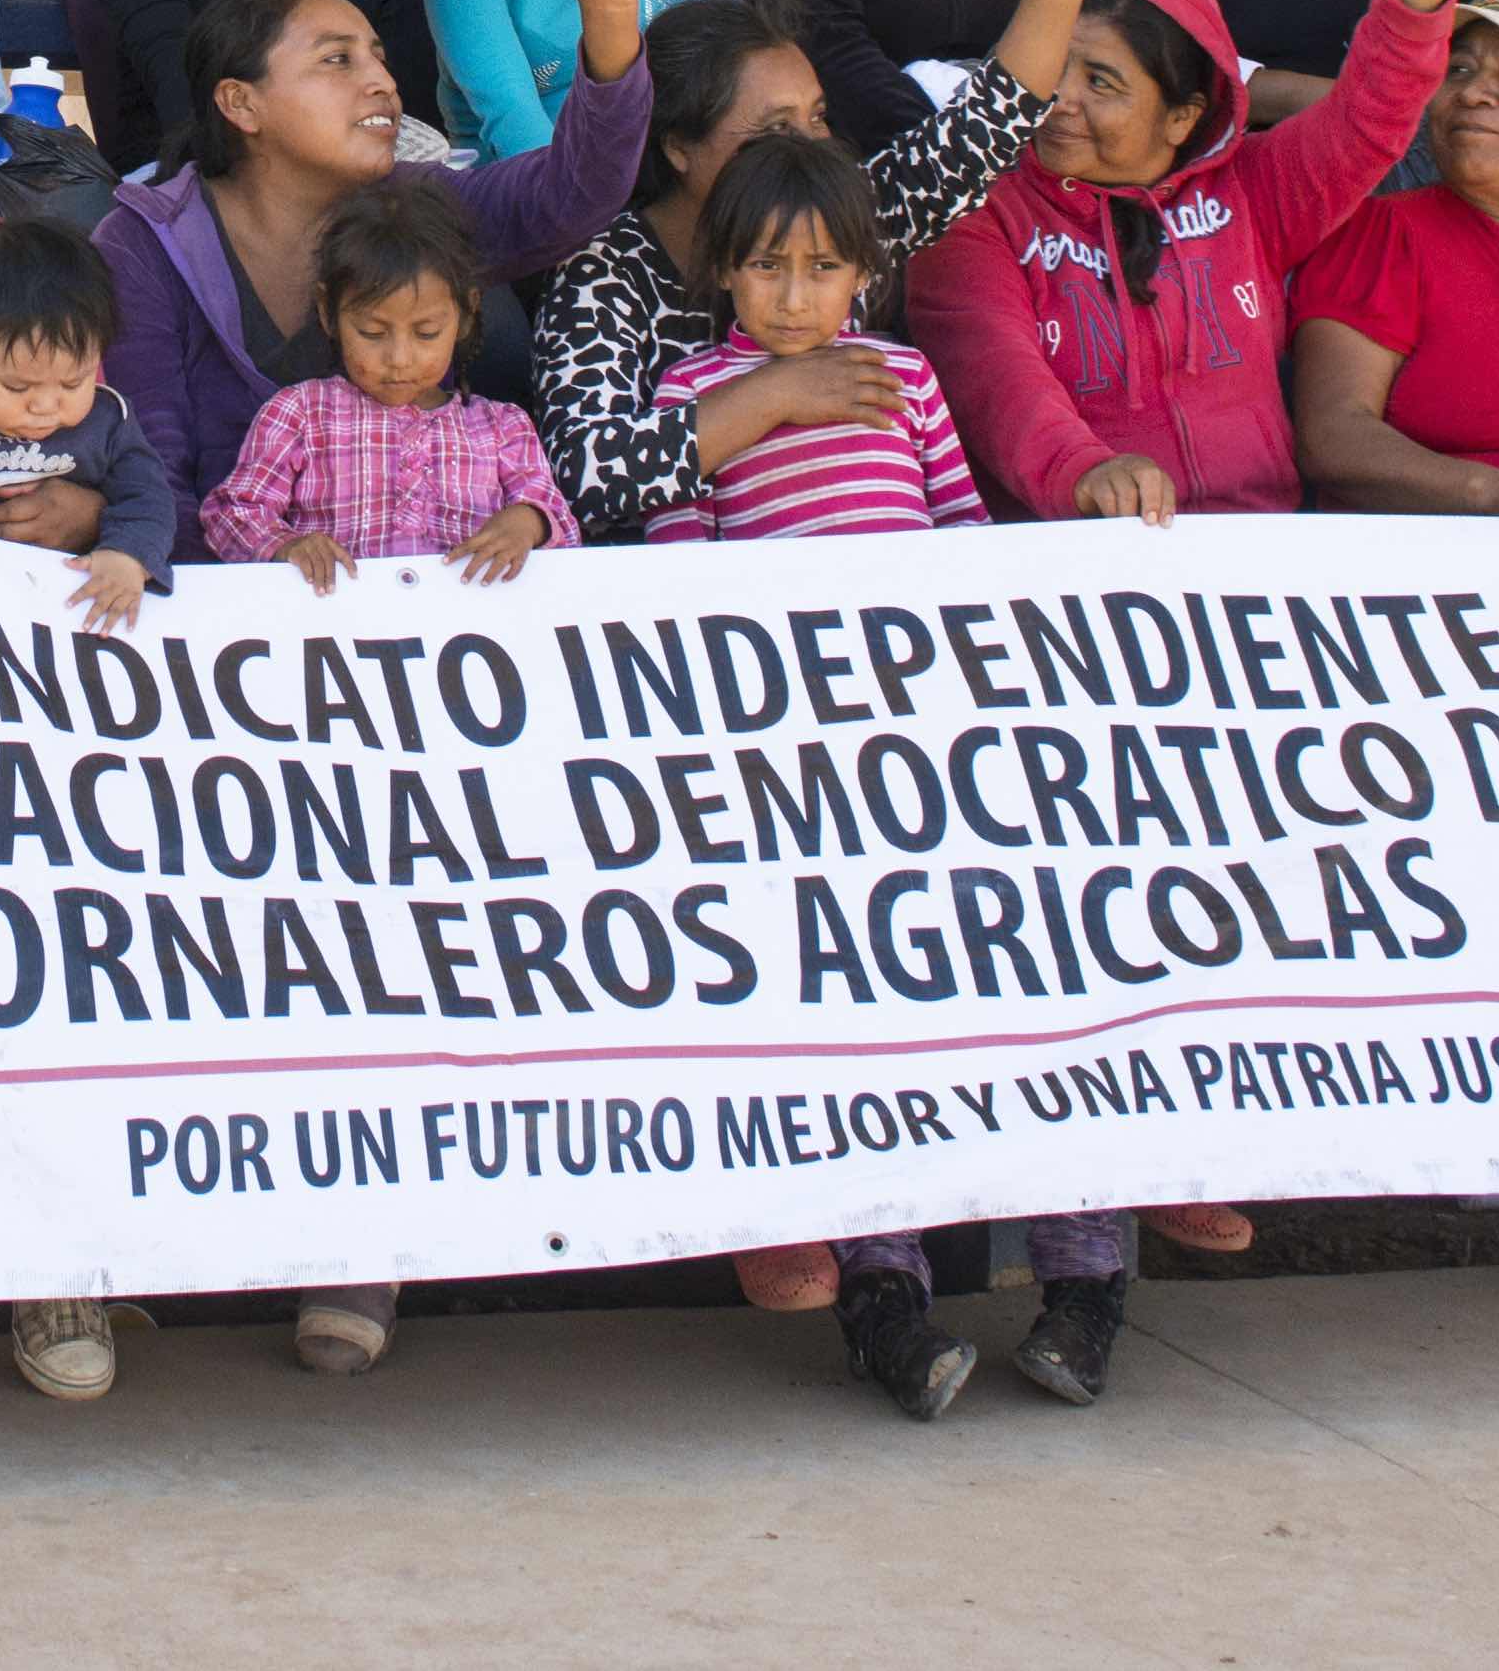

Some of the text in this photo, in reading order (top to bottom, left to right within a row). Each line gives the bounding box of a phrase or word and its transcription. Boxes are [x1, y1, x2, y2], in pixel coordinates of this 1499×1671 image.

[1232, 281, 1261, 319] 87
[563, 720, 1436, 871] DEMOCRATICO
[800, 837, 1469, 1005] AGRICOLAS
[126, 1113, 276, 1198] POR
[293, 1107, 399, 1187] UN
[420, 1097, 696, 1182] FUTURO
[715, 1084, 956, 1170] MEJOR
[954, 1081, 1004, 1133] Y
[1016, 1047, 1179, 1125] UNA
[1182, 1039, 1414, 1112] PATRIA
